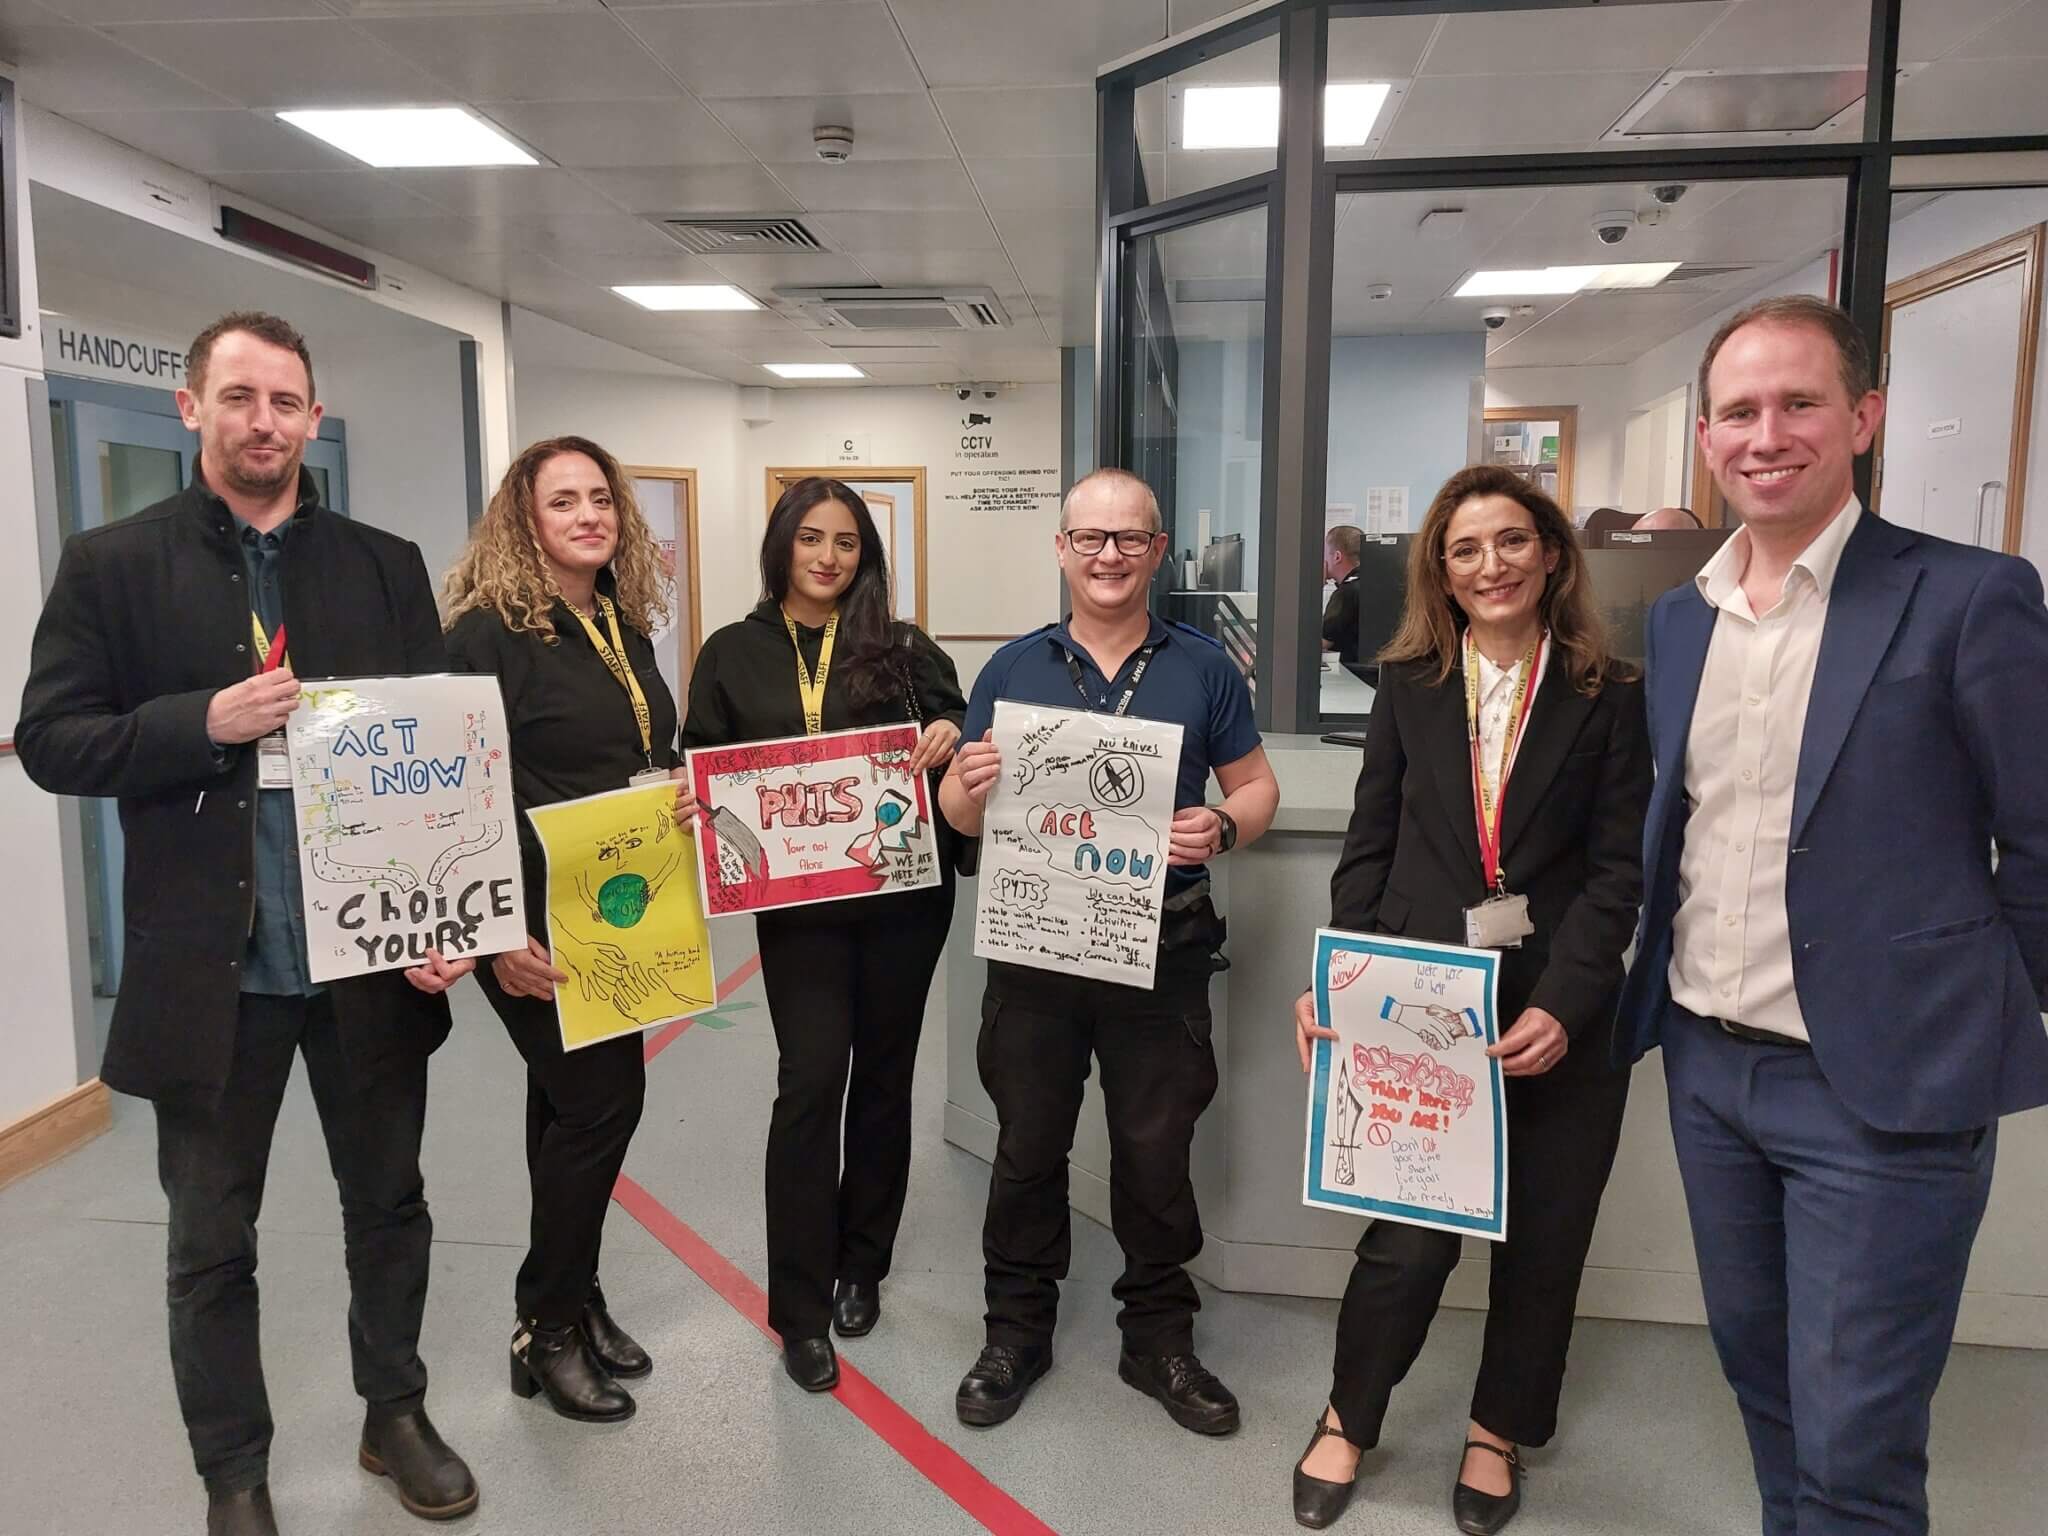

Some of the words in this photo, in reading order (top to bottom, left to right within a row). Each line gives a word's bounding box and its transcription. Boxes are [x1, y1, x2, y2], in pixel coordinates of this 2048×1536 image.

[844, 439, 853, 451] C
[961, 436, 992, 449] CCTV
[964, 450, 999, 460] operation
[825, 617, 836, 638] STAFF
[600, 646, 622, 675] STAFF
[1132, 660, 1146, 683] STAFF
[815, 661, 828, 685] STAFF
[1517, 678, 1527, 701] STAFF
[810, 711, 821, 735] TAFF
[1508, 715, 1517, 738] STAFF
[333, 718, 418, 757] ACT
[371, 756, 466, 796] NOW
[782, 837, 806, 855] Your
[812, 841, 829, 852] not
[895, 853, 913, 867] WE
[1002, 878, 1040, 901] PYJS
[1089, 888, 1102, 898] We
[1106, 893, 1124, 901] can
[1129, 893, 1151, 911] help
[1014, 912, 1034, 920] with
[334, 946, 347, 957] is
[355, 920, 480, 967] YOURS
[1332, 963, 1357, 986] NOW
